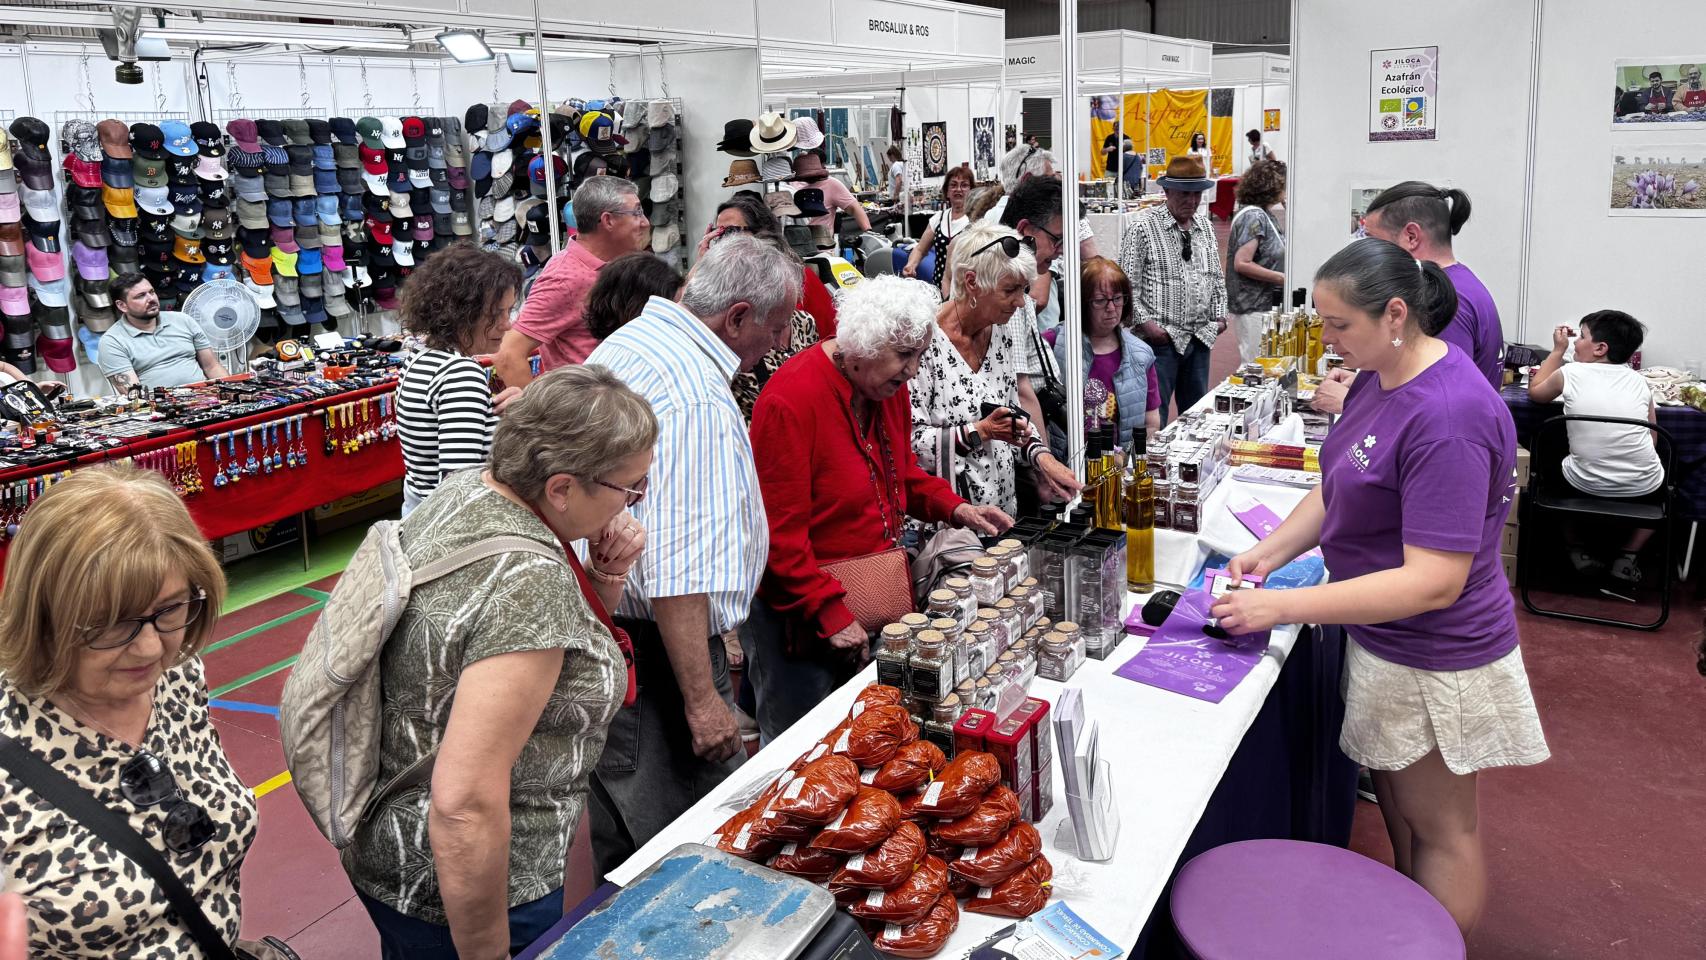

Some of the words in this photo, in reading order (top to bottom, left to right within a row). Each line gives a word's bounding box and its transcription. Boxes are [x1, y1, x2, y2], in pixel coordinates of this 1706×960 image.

[868, 19, 908, 34] BROSALUX
[909, 24, 914, 35] &
[915, 25, 929, 37] ROS
[1008, 56, 1036, 65] MAGIC
[1385, 72, 1421, 82] Azafrán
[1381, 85, 1425, 95] Ecológico
[1163, 650, 1224, 672] JILOCA
